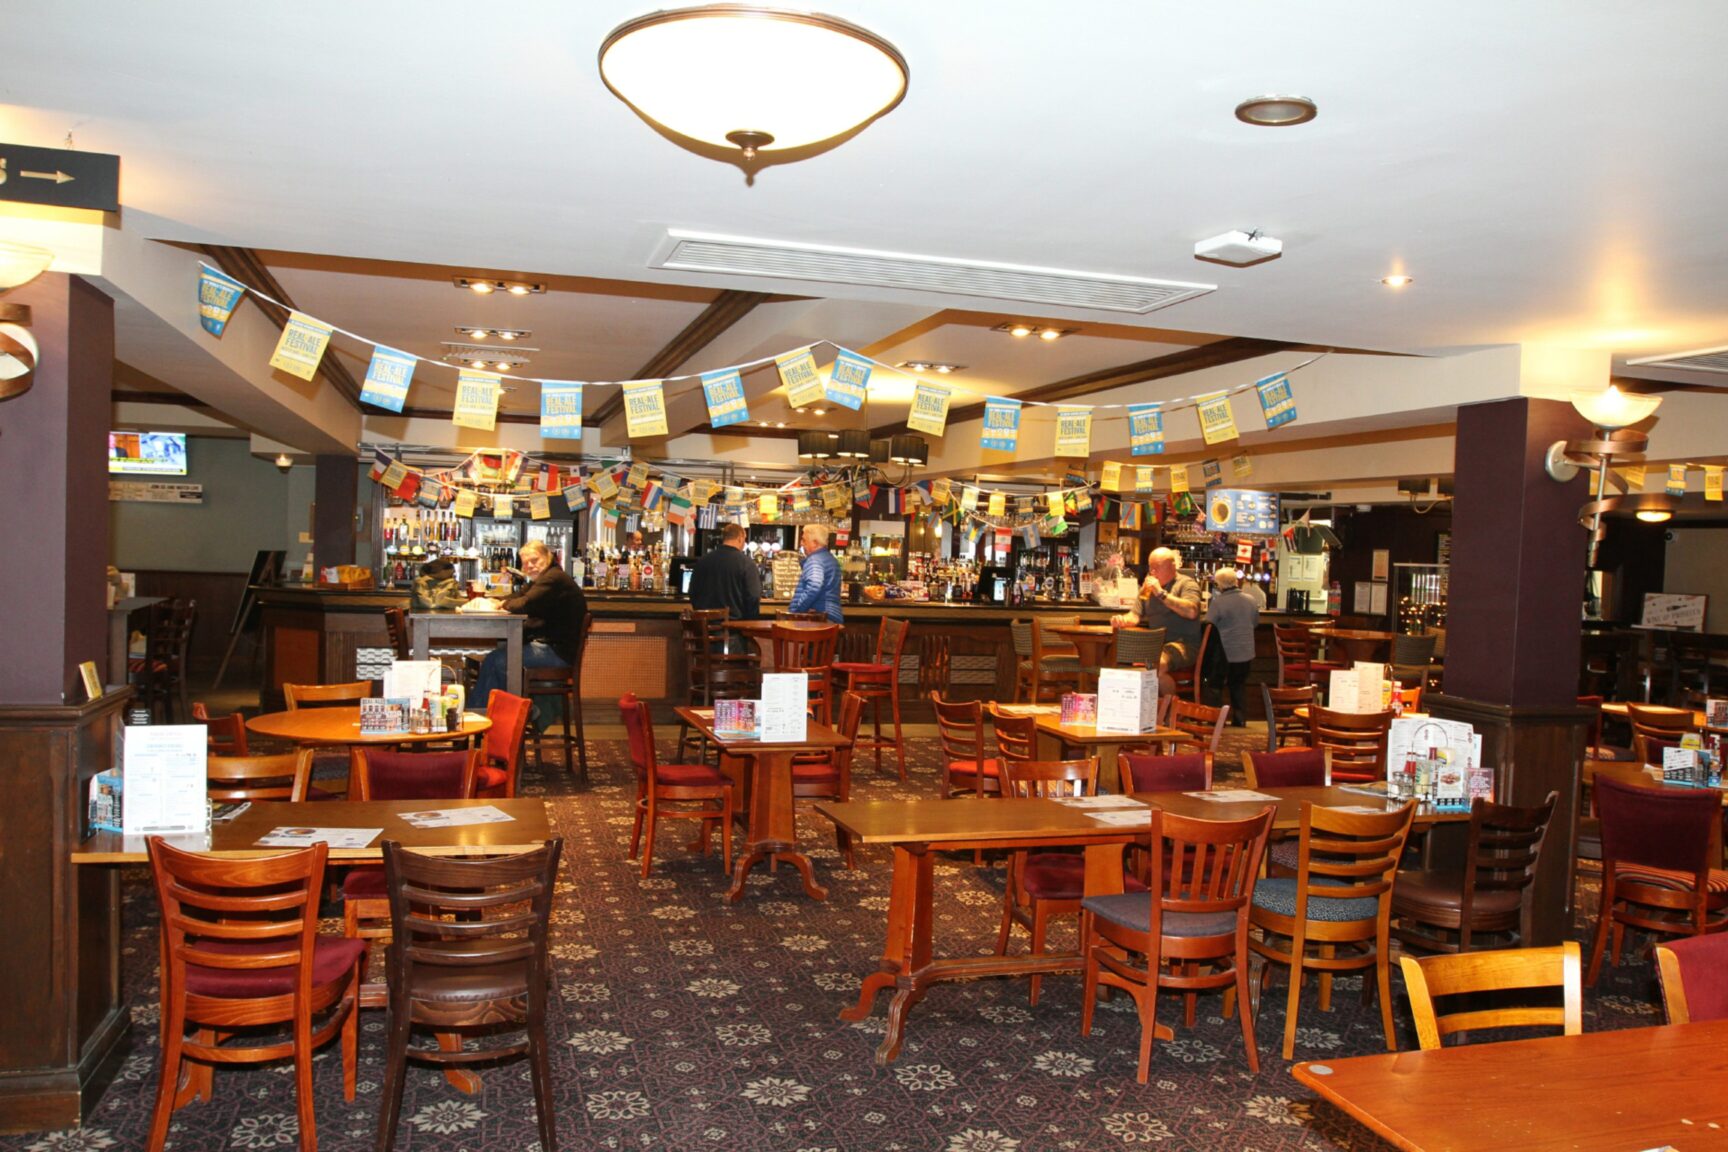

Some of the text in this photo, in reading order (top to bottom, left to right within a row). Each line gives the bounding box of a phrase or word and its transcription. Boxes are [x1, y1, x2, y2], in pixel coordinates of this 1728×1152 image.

[285, 336, 318, 354] FESTIVAL
[372, 371, 405, 384] FESTIVAL
[787, 371, 814, 385] FESTIVAL
[837, 371, 865, 385] FESTIVAL
[461, 394, 492, 405] FESTIVAL
[711, 390, 739, 404] FESTIVAL
[545, 404, 577, 414] FESTIVAL
[630, 402, 660, 414] FESTIVAL
[916, 401, 943, 413] FESTIVAL
[1060, 426, 1086, 435] FESTIVAL
